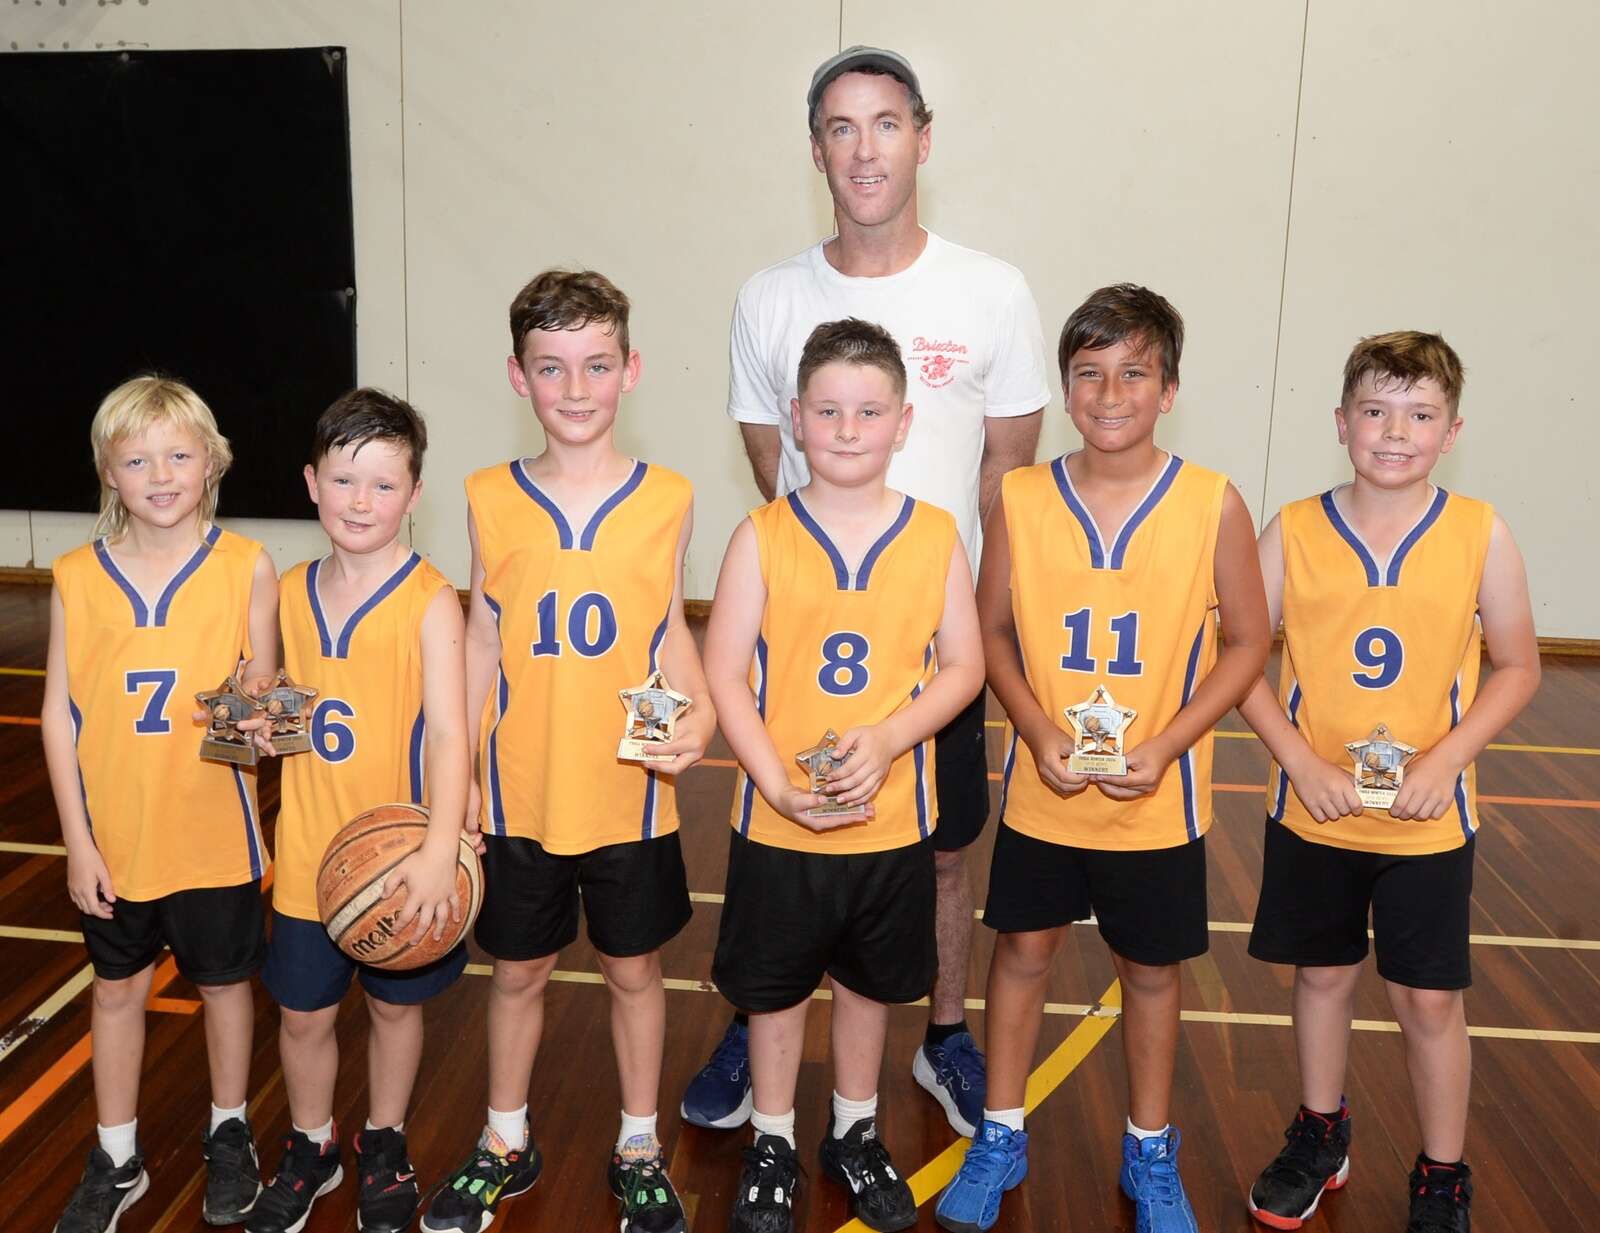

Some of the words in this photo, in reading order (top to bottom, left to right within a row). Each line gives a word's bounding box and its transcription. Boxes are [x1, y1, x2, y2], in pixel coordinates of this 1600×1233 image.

[912, 336, 968, 354] Brixton
[531, 589, 618, 659] 10
[1060, 607, 1143, 677] 11
[817, 630, 871, 697] 8
[1351, 625, 1405, 691] 9
[124, 669, 178, 735] 7
[310, 698, 357, 765] 6
[352, 910, 402, 957] molt
